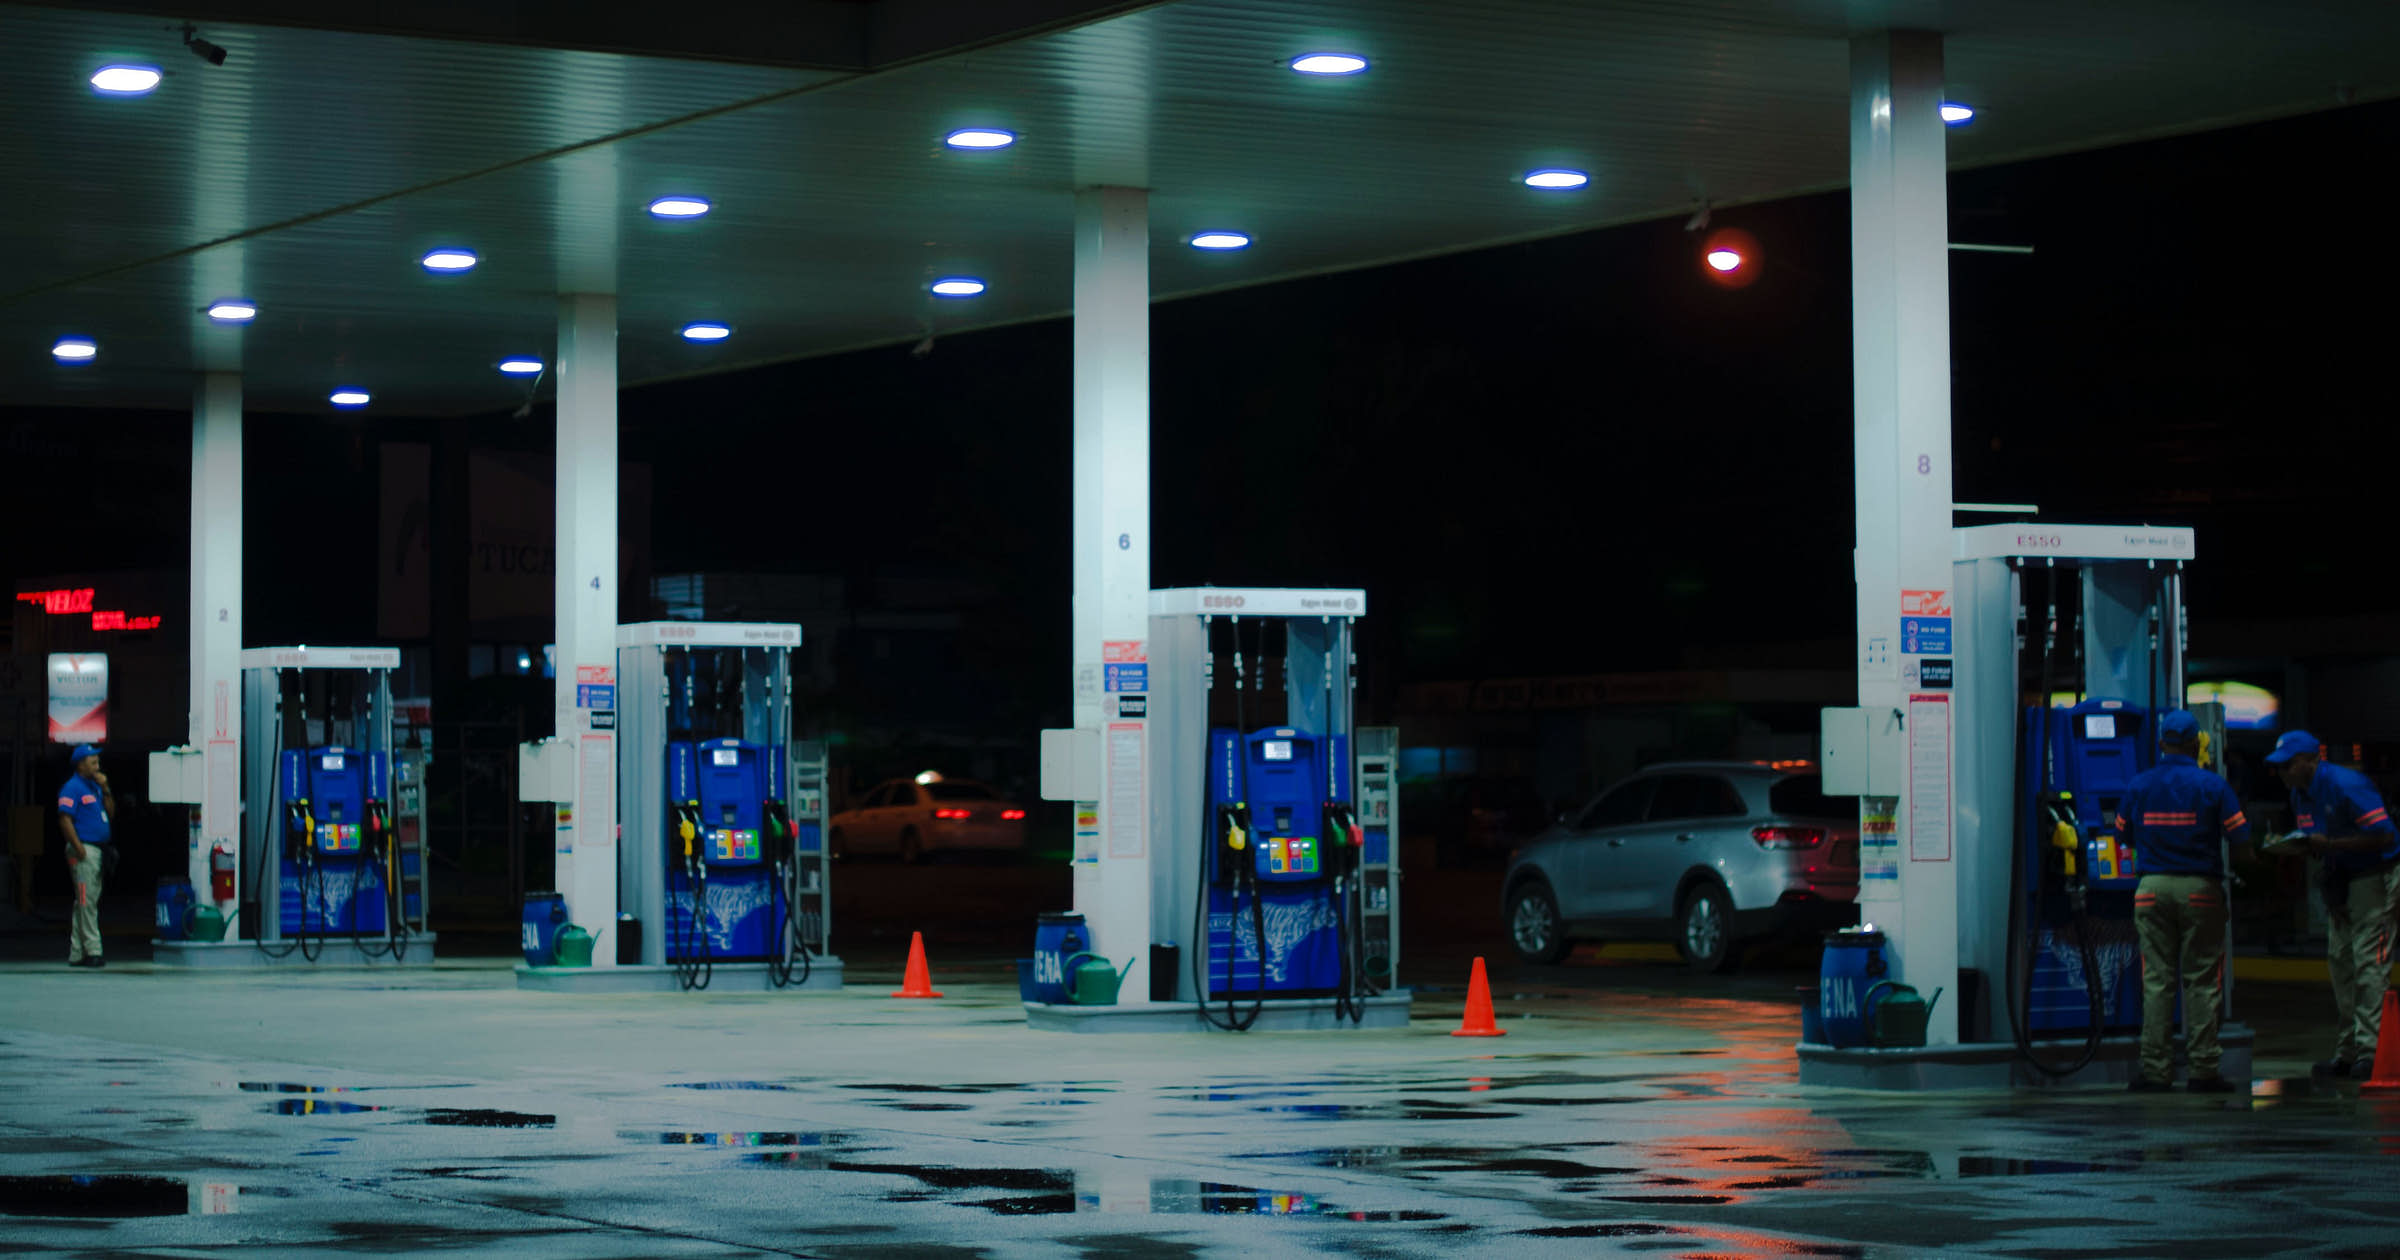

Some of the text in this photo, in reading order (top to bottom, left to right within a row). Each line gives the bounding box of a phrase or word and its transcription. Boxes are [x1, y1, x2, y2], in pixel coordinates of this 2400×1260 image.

[1917, 454, 1931, 475] 8
[1119, 533, 1130, 550] 6
[2017, 535, 2062, 548] ESSO
[590, 577, 600, 590] 4
[1203, 595, 1245, 608] ESSO
[218, 608, 229, 622] 2
